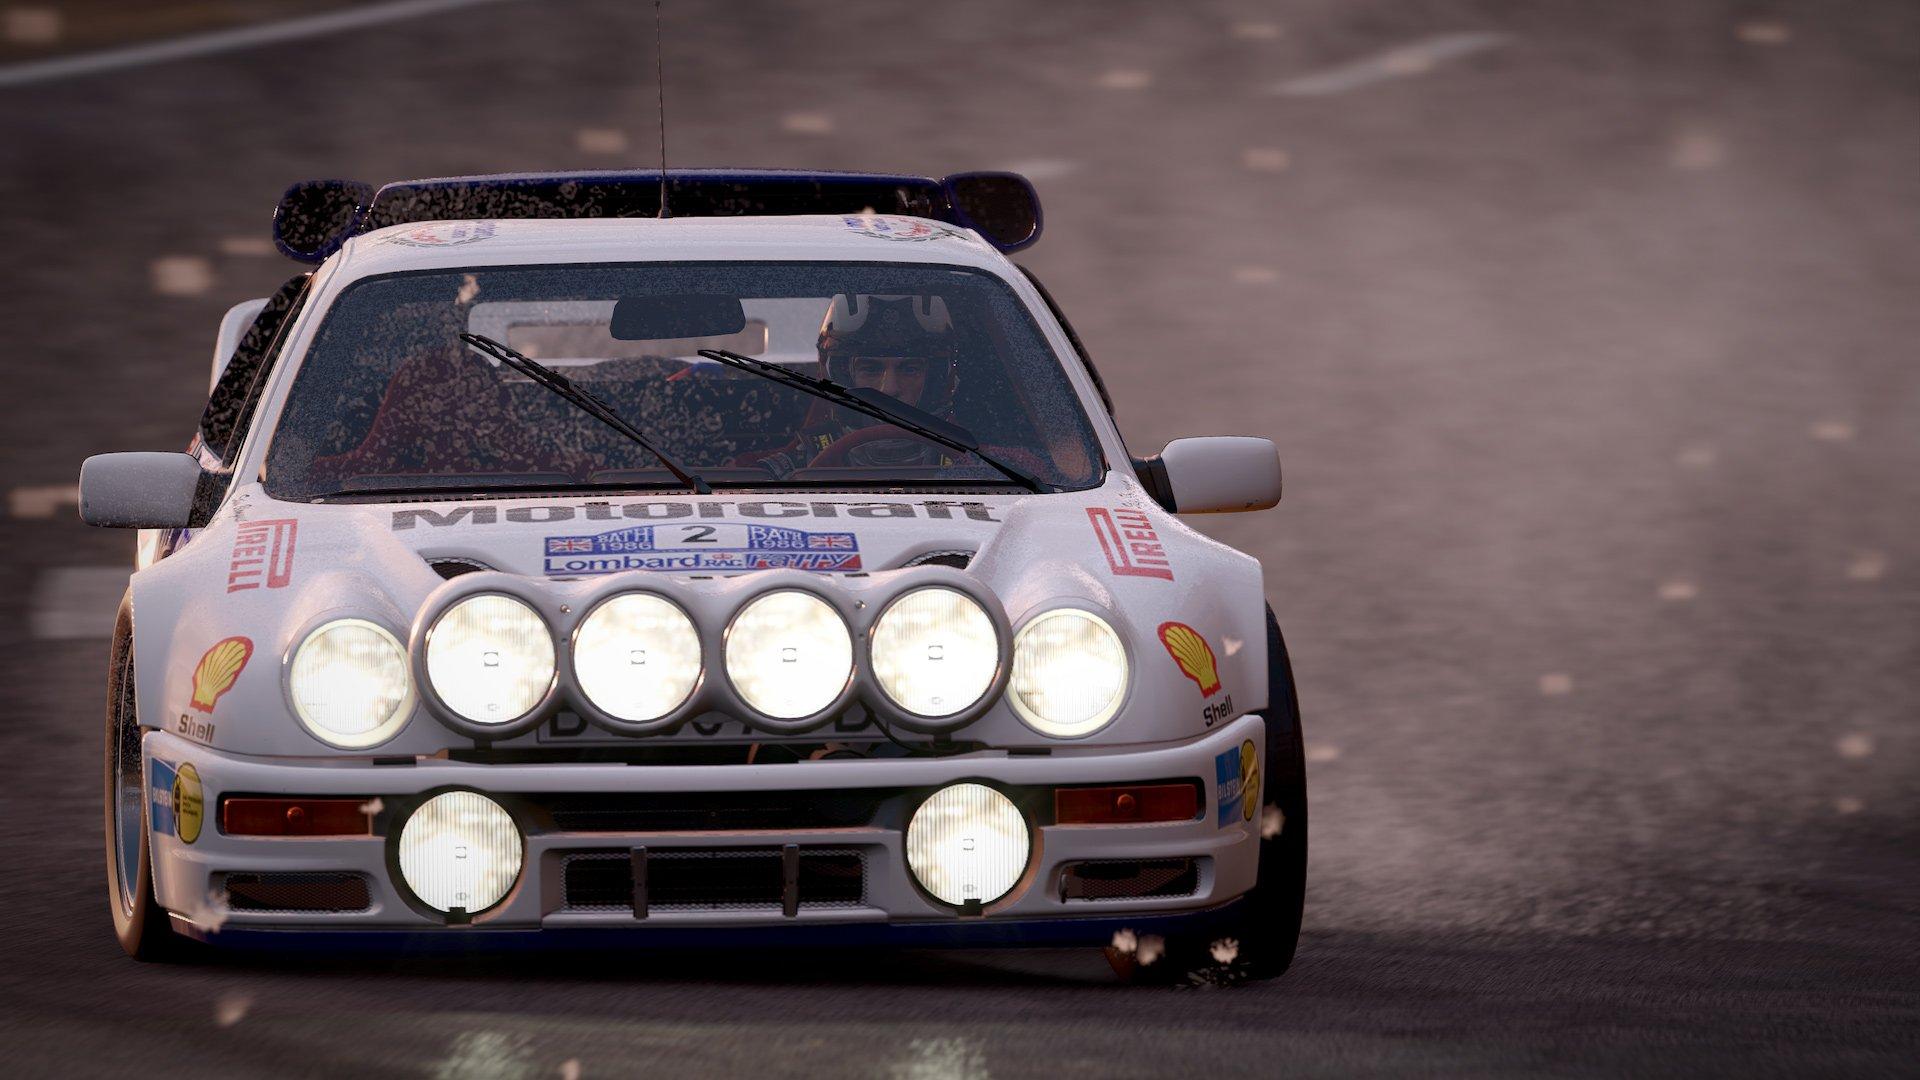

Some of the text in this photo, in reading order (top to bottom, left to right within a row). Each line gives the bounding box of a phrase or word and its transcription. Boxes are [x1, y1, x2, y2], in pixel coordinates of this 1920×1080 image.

[392, 501, 1002, 531] Motorcraft
[597, 526, 649, 543] BATH
[681, 525, 718, 543] 2
[751, 527, 800, 541] BATH
[600, 542, 650, 551] 1986
[753, 539, 804, 549] 1986
[1085, 507, 1175, 582] PIRELLI
[227, 518, 298, 594] PIRELLI
[544, 555, 700, 572] Lombard
[704, 558, 742, 567] RAC
[1203, 695, 1233, 727] Shell
[179, 713, 215, 744] Shell
